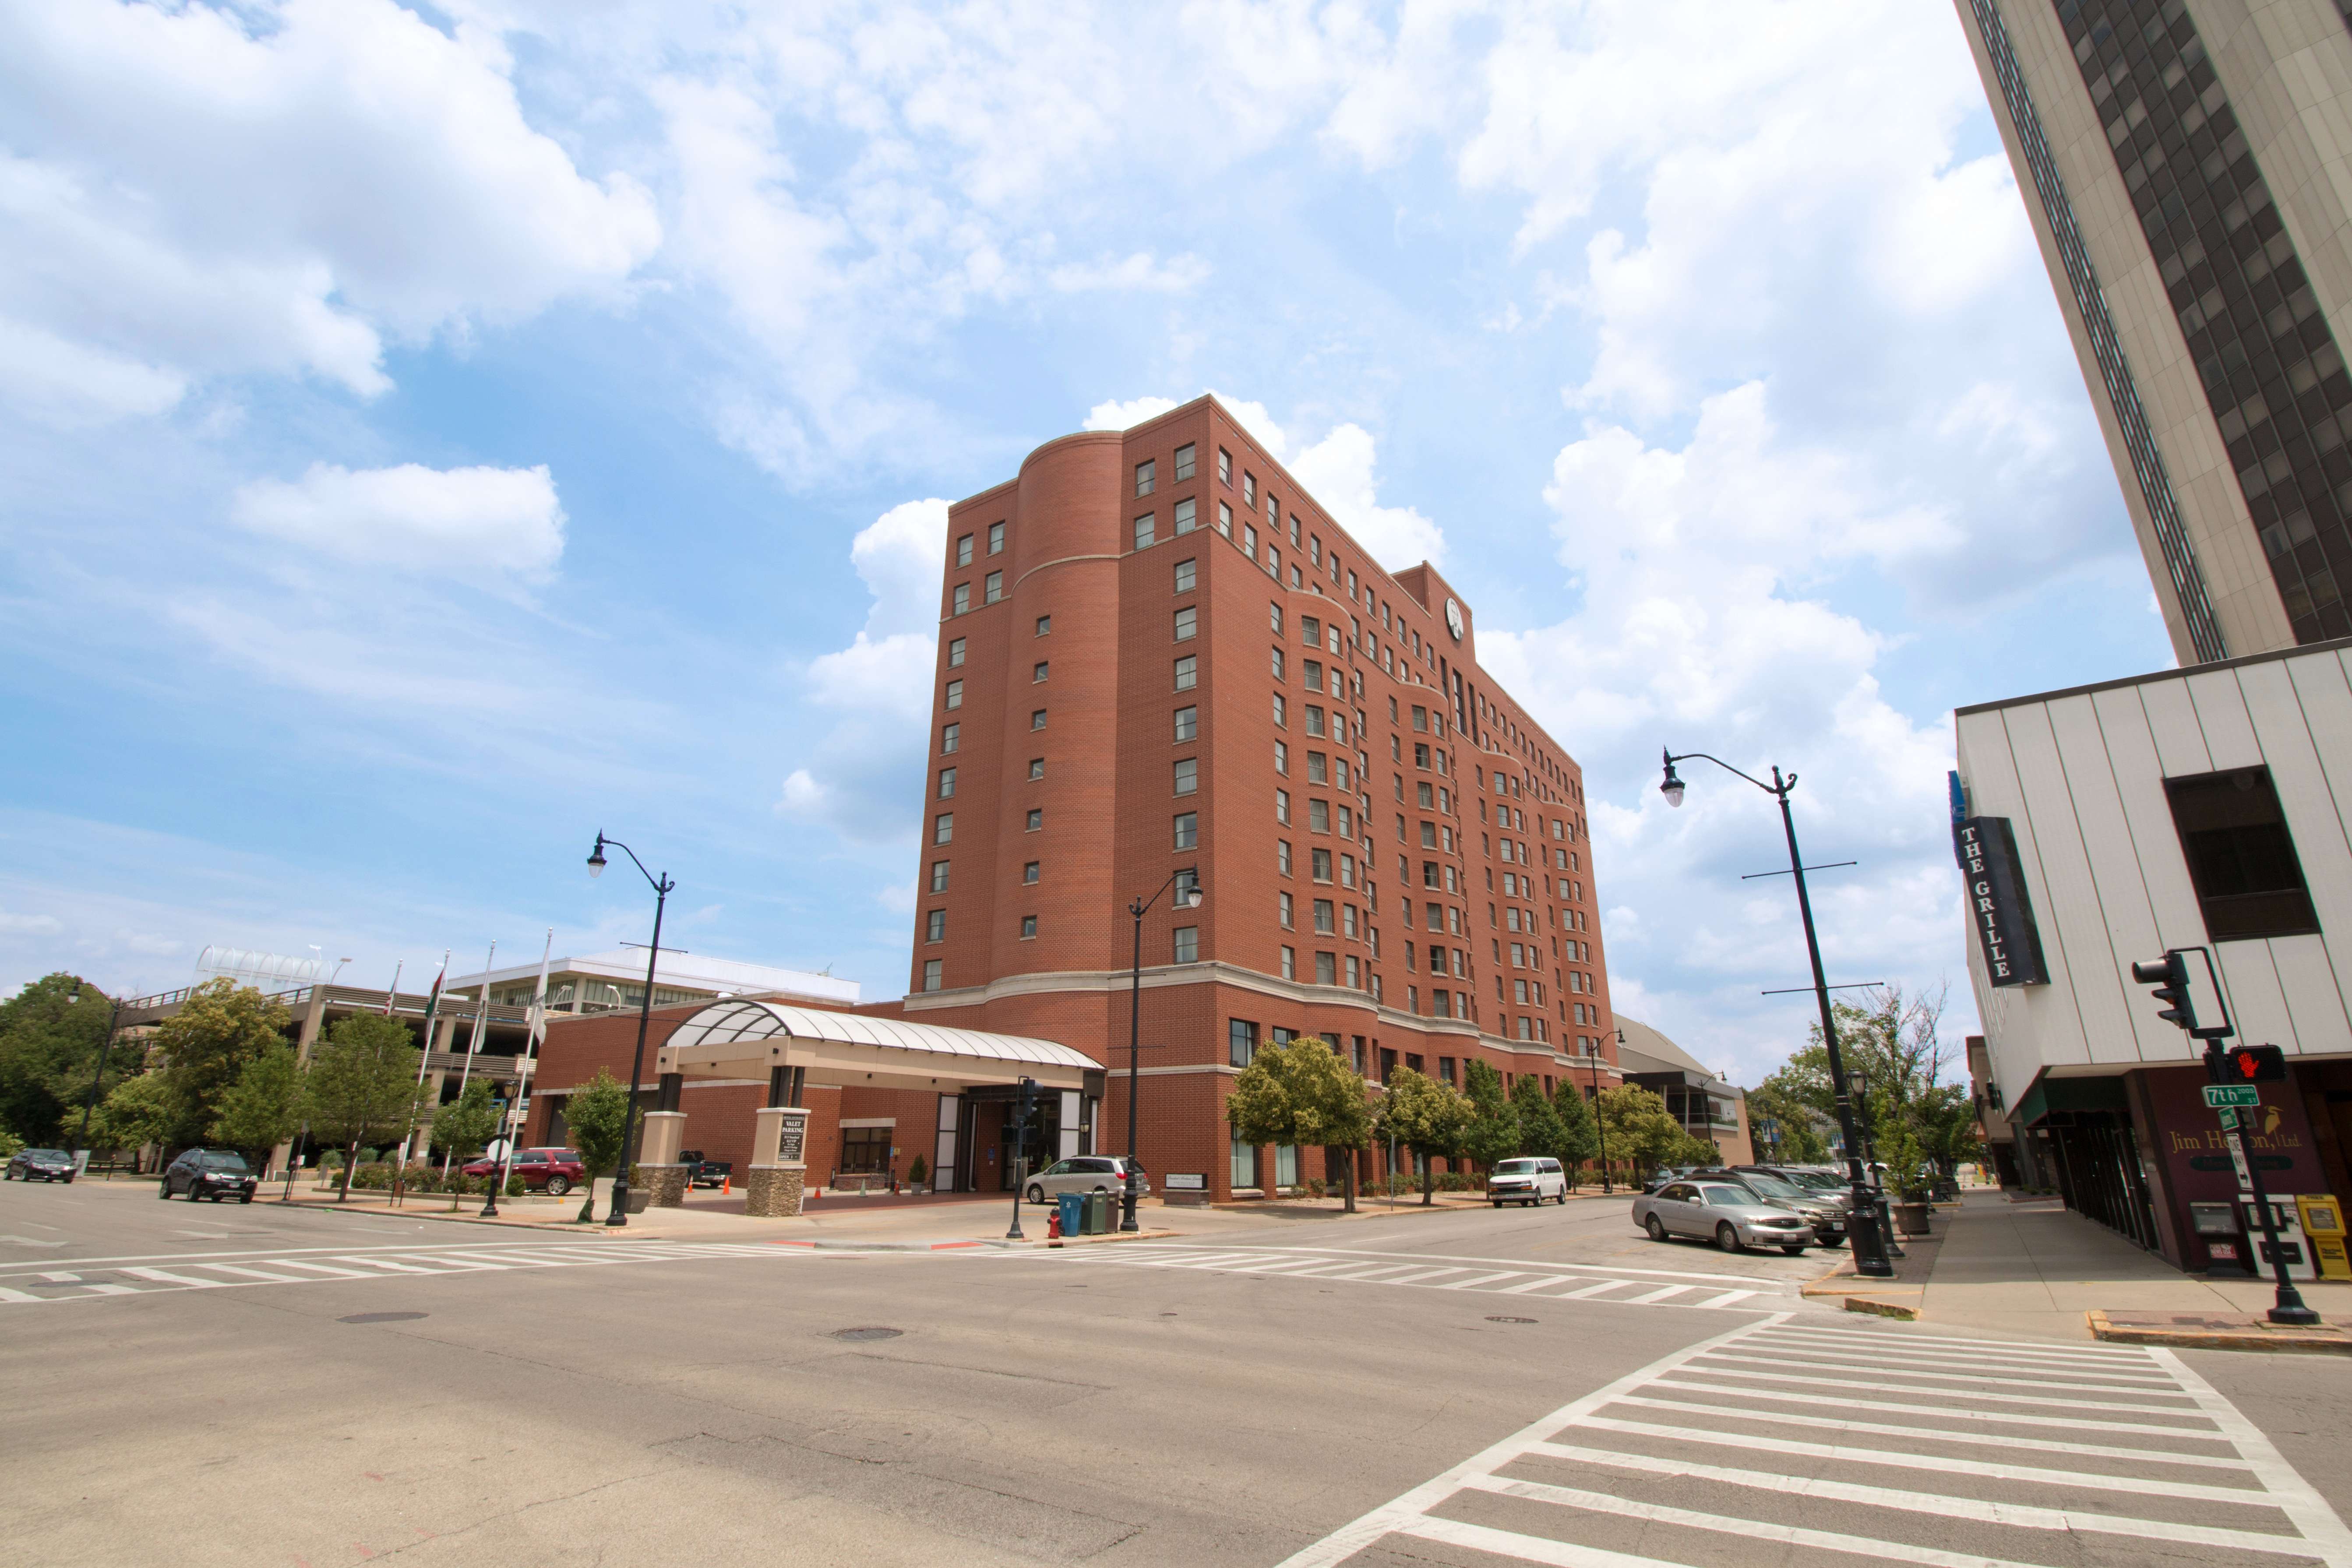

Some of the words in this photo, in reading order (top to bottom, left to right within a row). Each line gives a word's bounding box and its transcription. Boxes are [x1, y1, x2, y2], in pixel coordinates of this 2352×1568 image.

[1962, 827, 1984, 874] THE
[1975, 881, 2010, 977] GRILLE
[2207, 1089, 2239, 1103] 7th
[2169, 1131, 2201, 1153] Jim
[2204, 1131, 2275, 1150] Heon,
[2280, 1134, 2303, 1147] Ltd.
[2229, 1139, 2241, 1151] ONE
[2234, 1154, 2245, 1166] WAY
